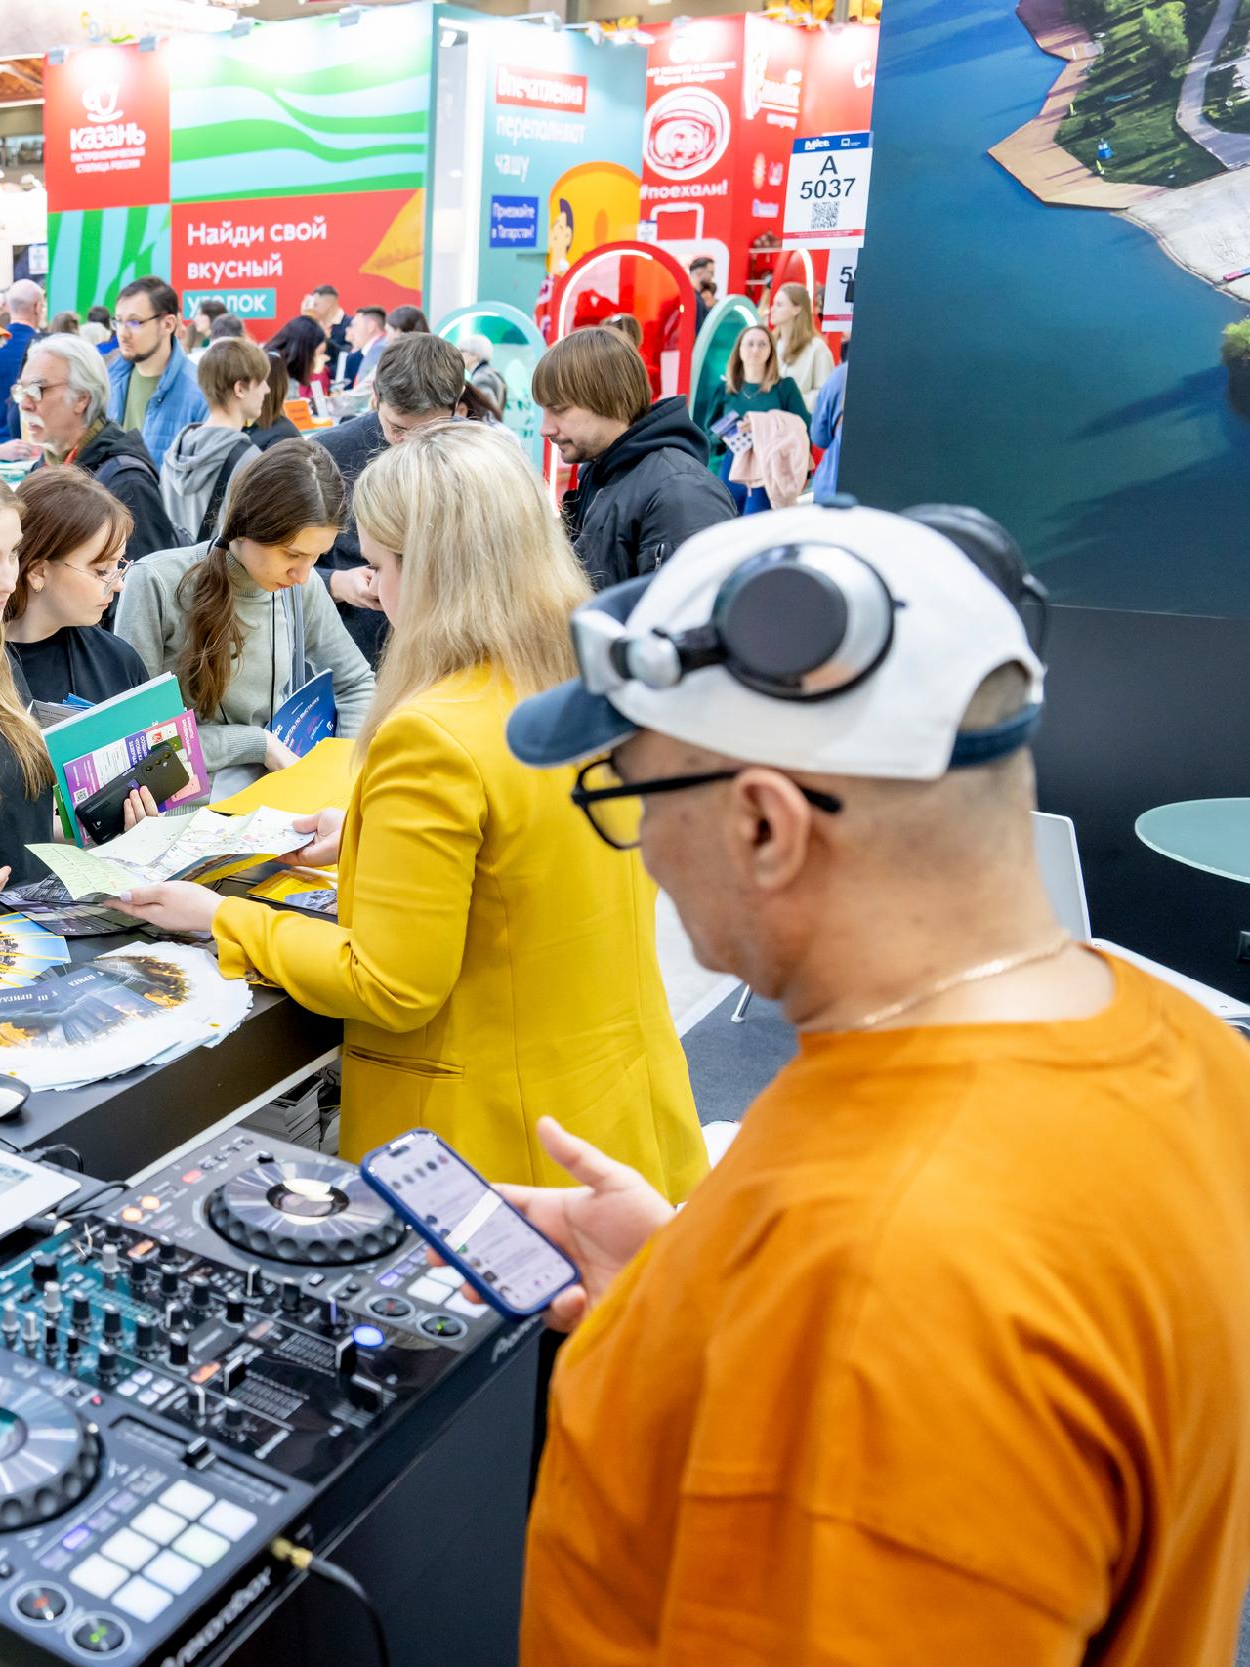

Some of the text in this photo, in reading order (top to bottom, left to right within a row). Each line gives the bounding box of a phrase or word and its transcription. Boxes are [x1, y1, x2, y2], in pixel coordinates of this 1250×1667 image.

[494, 153, 530, 183] чашу
[800, 178, 856, 200] 5037
[187, 215, 327, 248] Найди свой
[187, 252, 283, 285] вкусный
